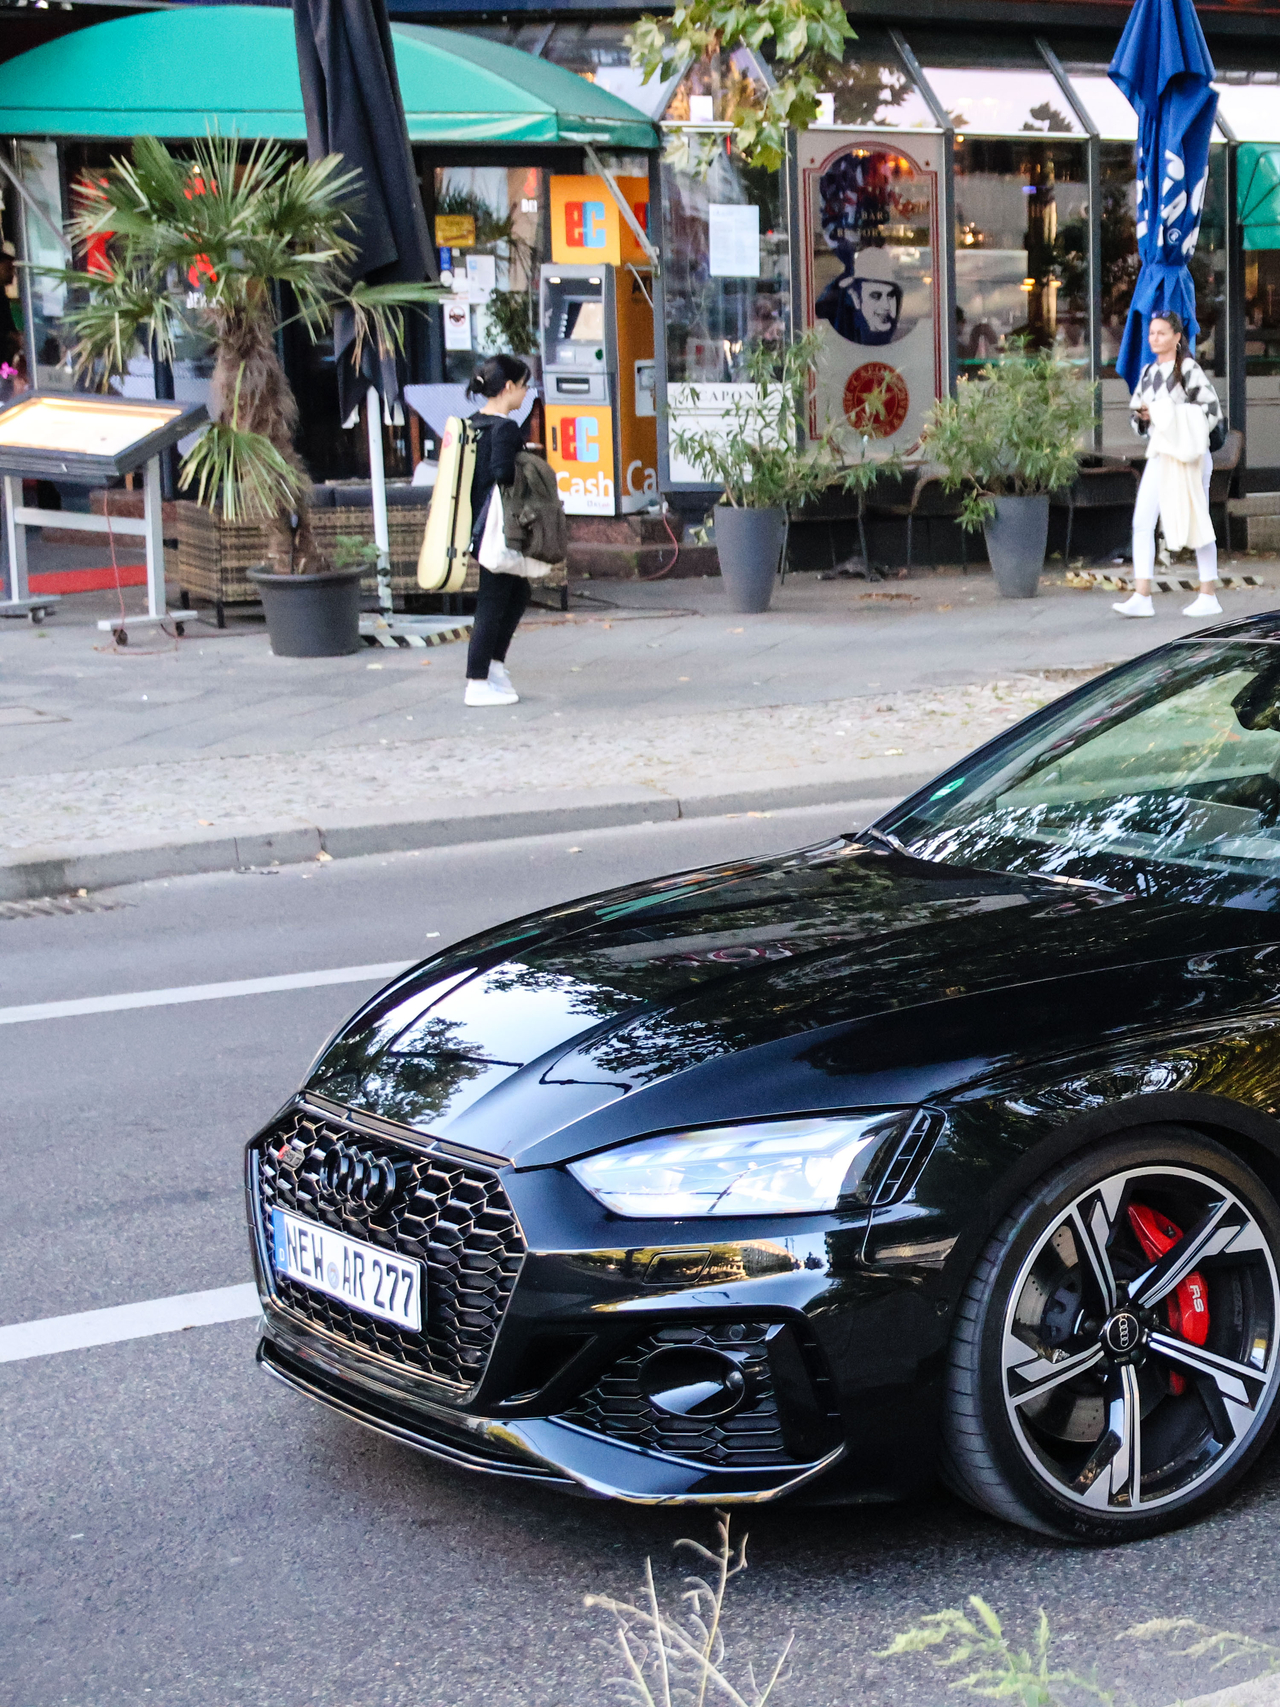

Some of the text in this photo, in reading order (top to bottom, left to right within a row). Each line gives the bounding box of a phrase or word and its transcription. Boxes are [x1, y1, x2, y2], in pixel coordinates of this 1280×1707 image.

[556, 471, 615, 498] Cash
[279, 1220, 415, 1318] D NEW AR 277
[1189, 1284, 1205, 1313] RS
